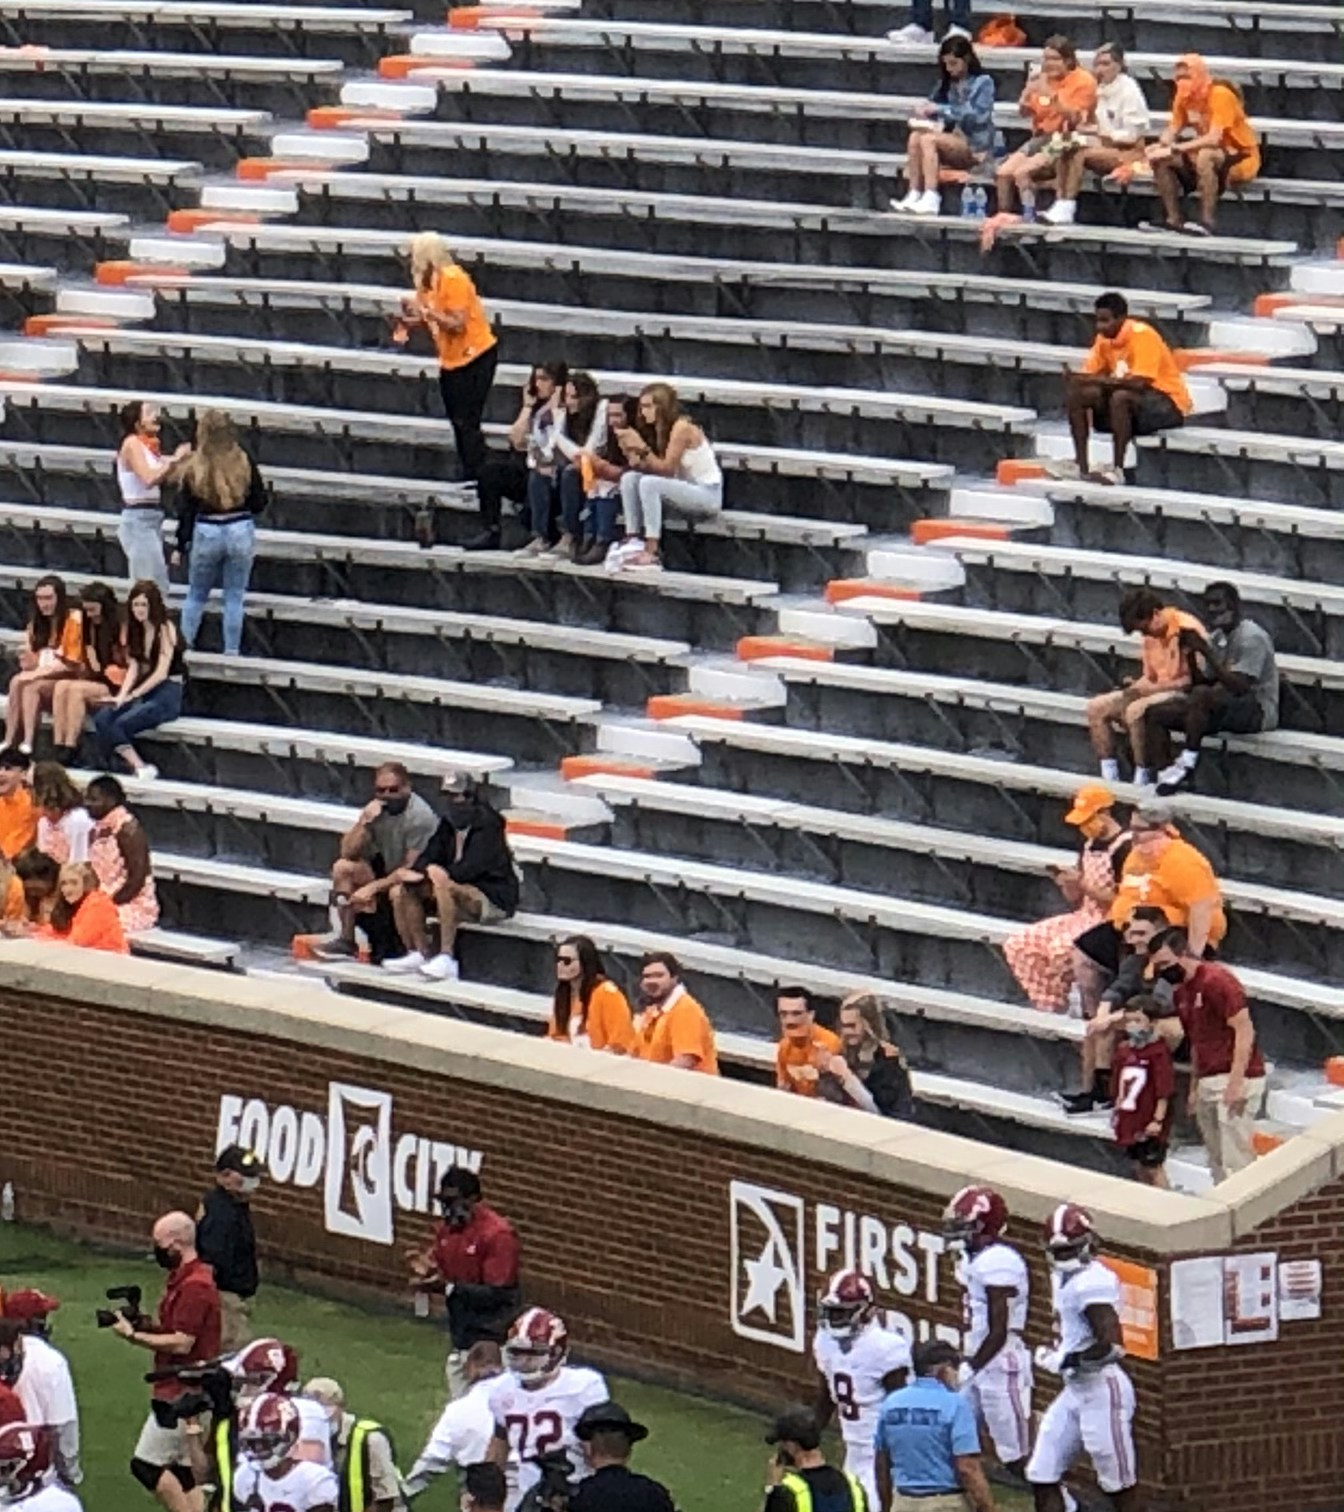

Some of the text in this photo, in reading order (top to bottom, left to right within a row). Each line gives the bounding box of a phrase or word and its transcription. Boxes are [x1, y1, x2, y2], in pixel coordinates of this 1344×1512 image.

[216, 1095, 325, 1186] FOOD
[816, 1202, 945, 1303] FIRST
[506, 1411, 562, 1463] 72
